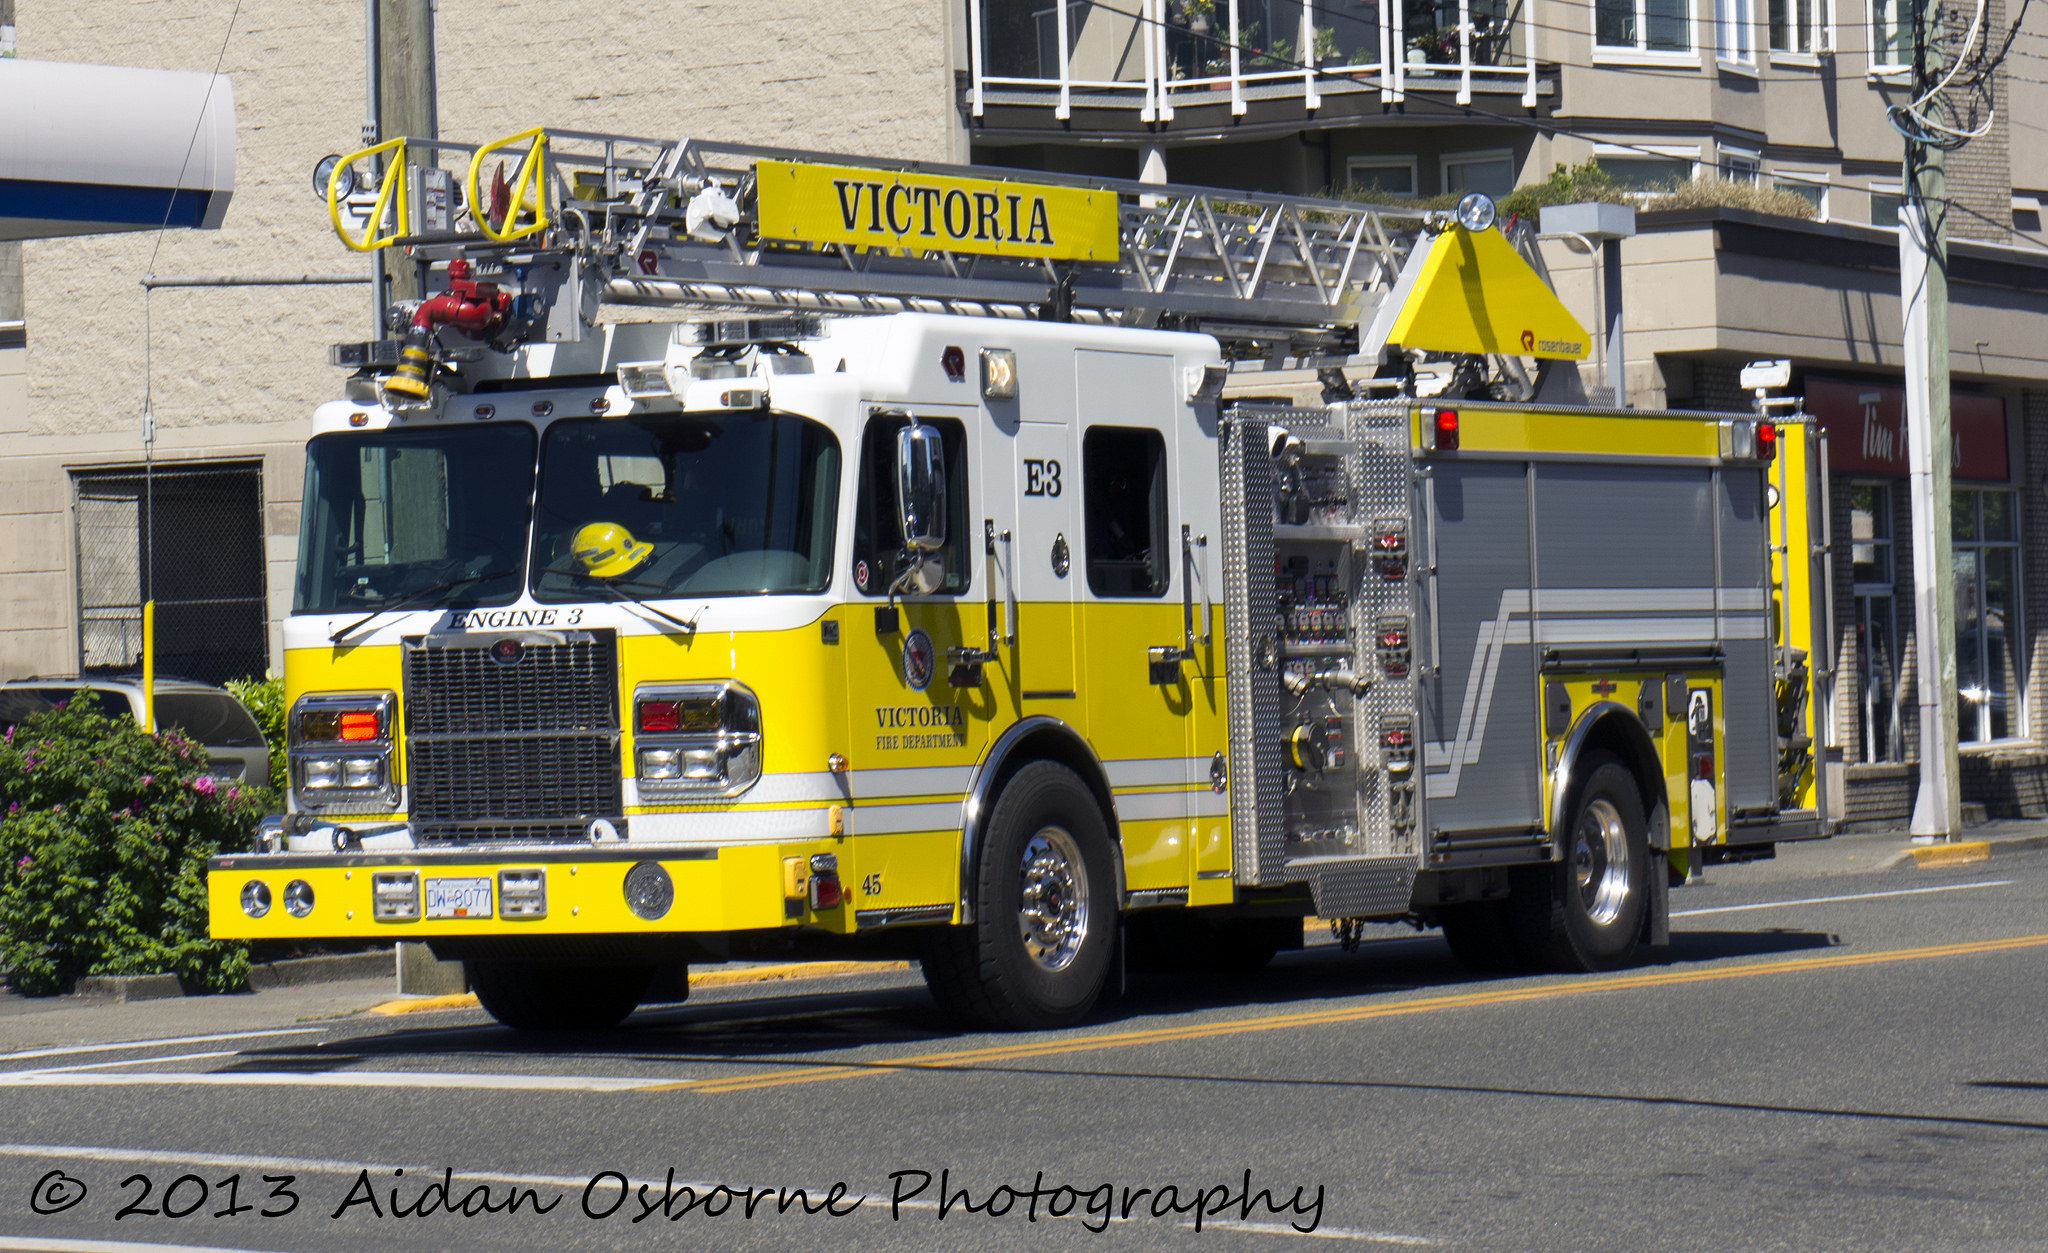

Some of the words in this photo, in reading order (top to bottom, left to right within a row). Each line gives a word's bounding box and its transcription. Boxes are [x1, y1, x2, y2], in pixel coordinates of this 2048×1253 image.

[833, 179, 1055, 246] VICTORIA
[1538, 337, 1583, 354] rosenbauer
[1858, 392, 1893, 463] Tim
[1023, 458, 1062, 498] E3
[447, 609, 558, 630] ENGINE
[567, 608, 584, 625] 3
[875, 704, 965, 728] VICTORIA
[876, 734, 899, 750] FIRE
[902, 731, 965, 749] DEPARTMENT
[862, 872, 882, 896] 45
